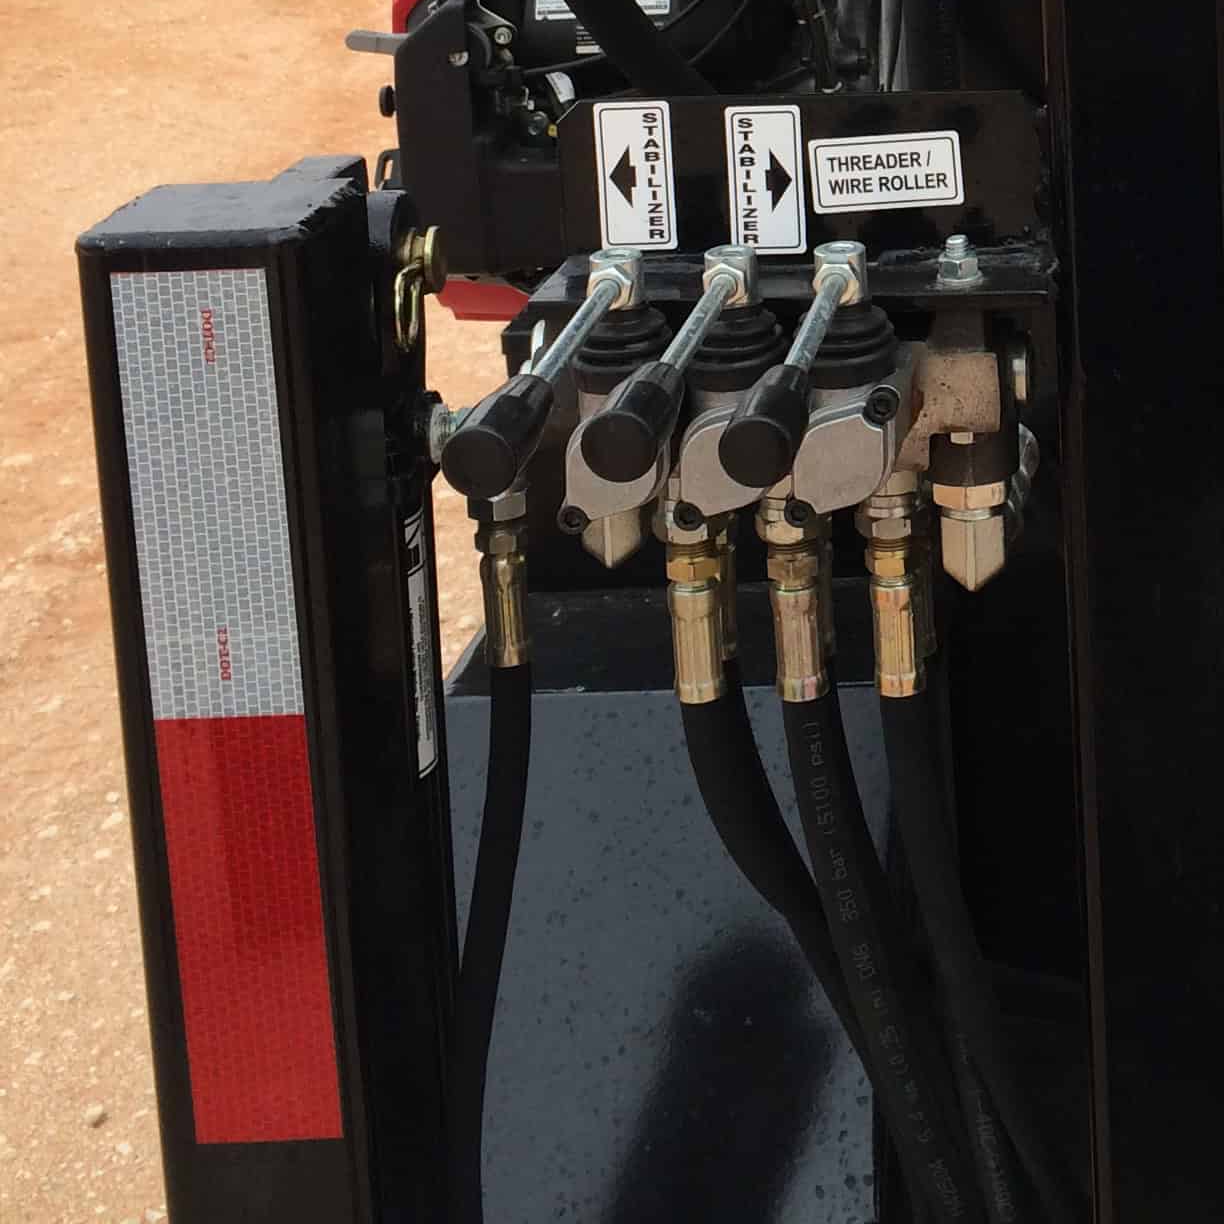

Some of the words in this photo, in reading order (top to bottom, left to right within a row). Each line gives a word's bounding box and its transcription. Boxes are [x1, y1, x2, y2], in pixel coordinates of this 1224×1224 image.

[642, 112, 665, 240] STABILIZER
[737, 117, 760, 244] STABILIZER
[826, 151, 922, 174] THREADER
[829, 176, 874, 196] WIRE
[879, 171, 948, 192] ROLLER
